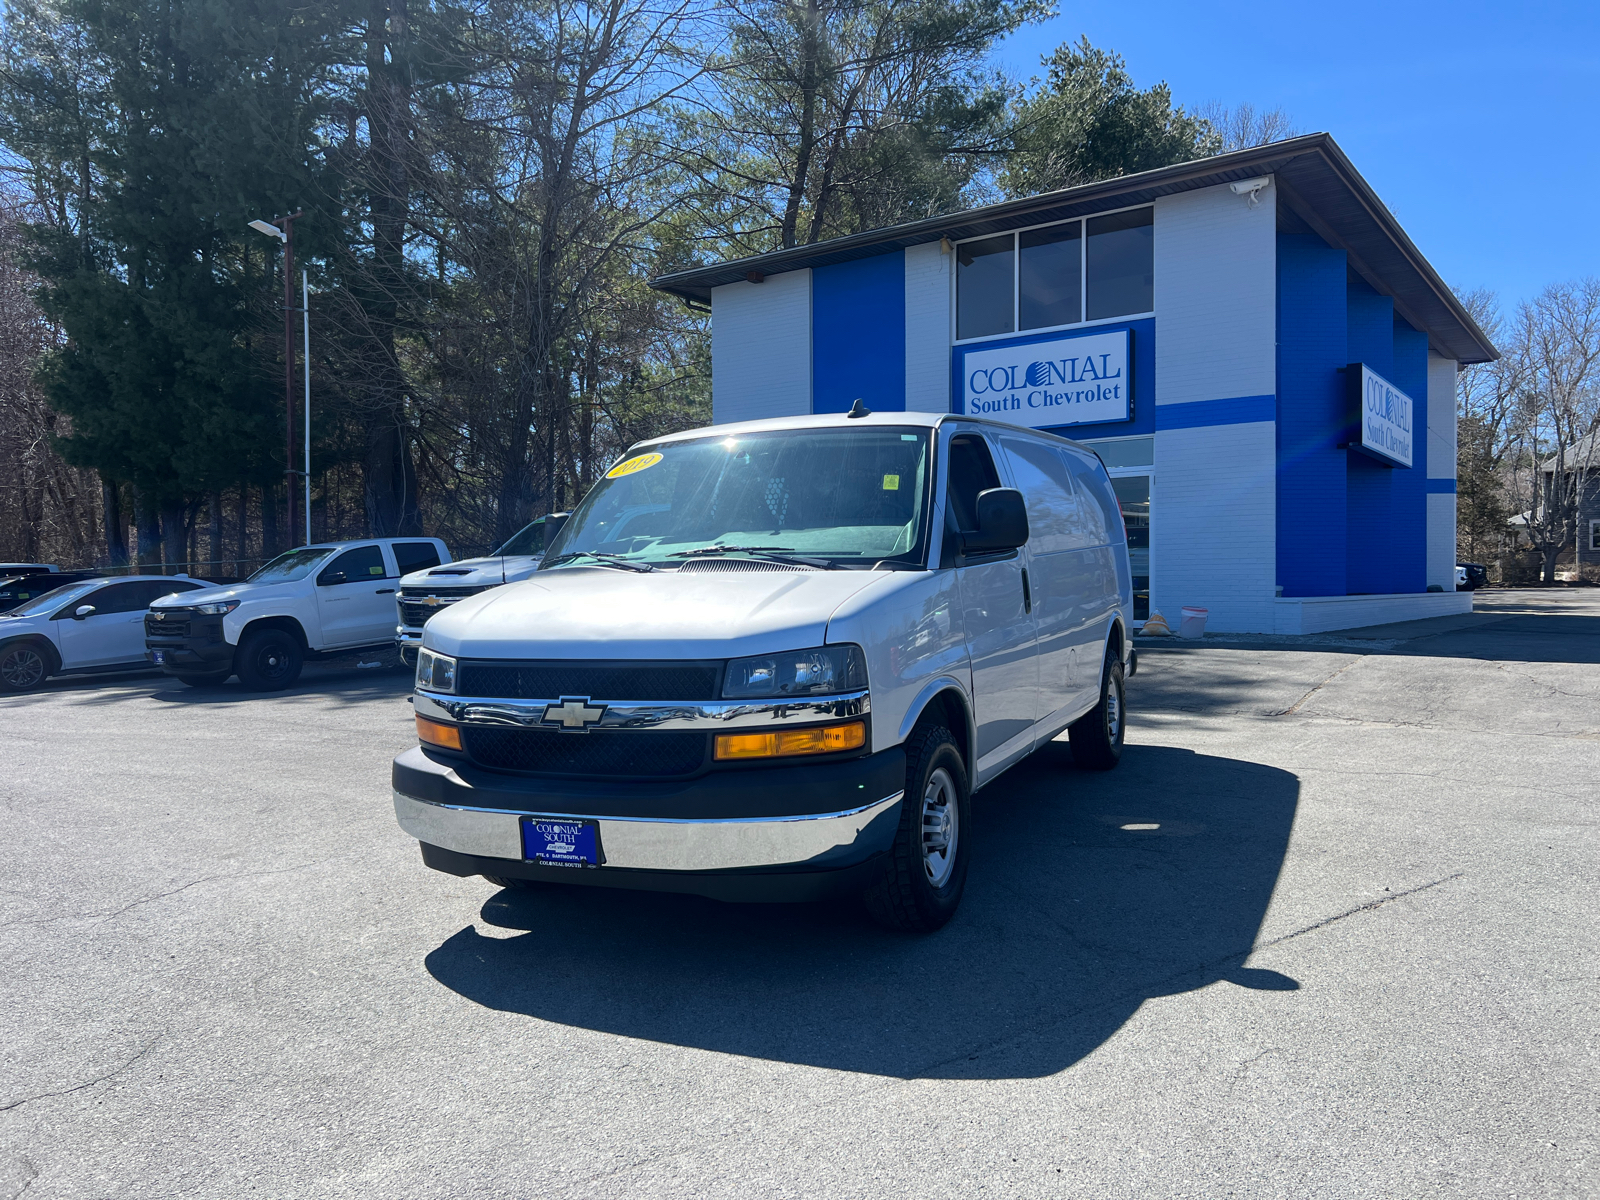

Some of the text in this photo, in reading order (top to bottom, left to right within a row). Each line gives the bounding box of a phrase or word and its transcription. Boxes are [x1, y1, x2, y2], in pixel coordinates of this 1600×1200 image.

[969, 353, 1121, 395] COLONIAL
[970, 383, 1121, 415] South Chevrolet
[1367, 376, 1410, 433] COLONIAL
[1367, 416, 1410, 459] South Chevrolet
[613, 456, 655, 476] 2019
[536, 824, 581, 834] COLONIAL
[544, 832, 574, 842] SOUTH
